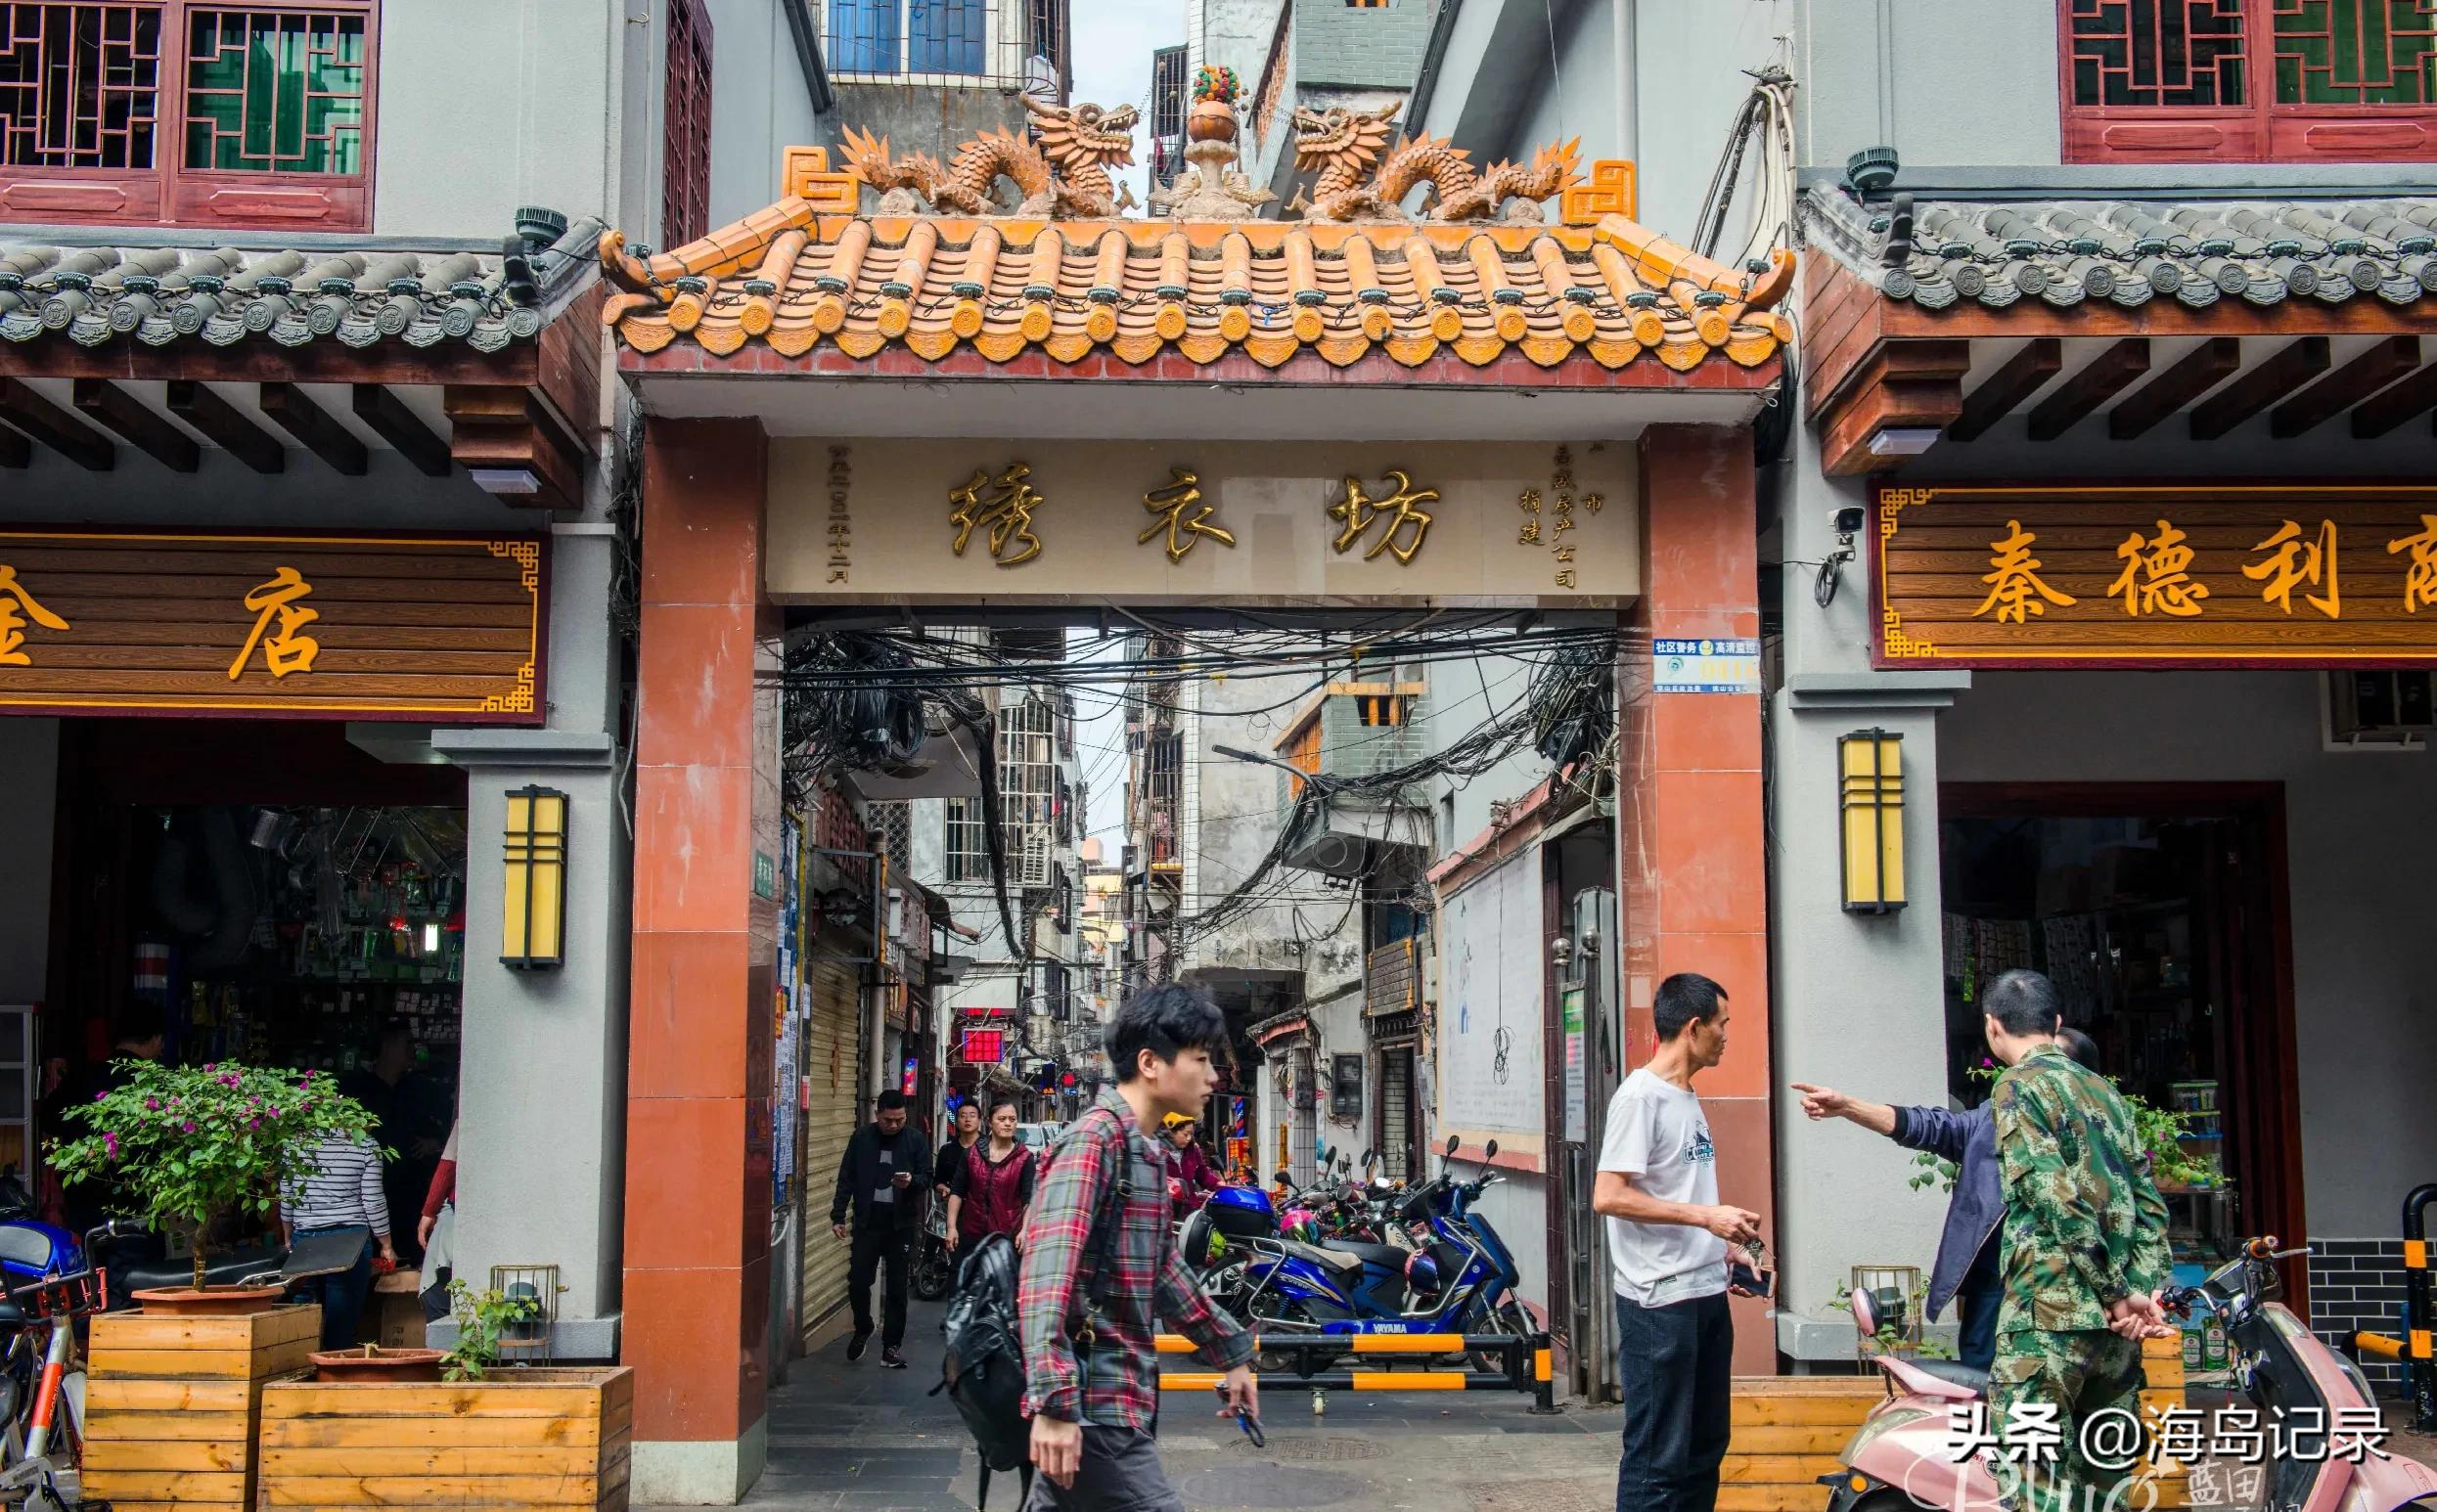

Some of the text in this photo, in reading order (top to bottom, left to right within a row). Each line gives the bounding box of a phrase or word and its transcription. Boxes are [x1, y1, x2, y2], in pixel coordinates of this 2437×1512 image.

[949, 460, 1442, 566] 绣衣坊
[1655, 641, 1697, 654] 社区警务
